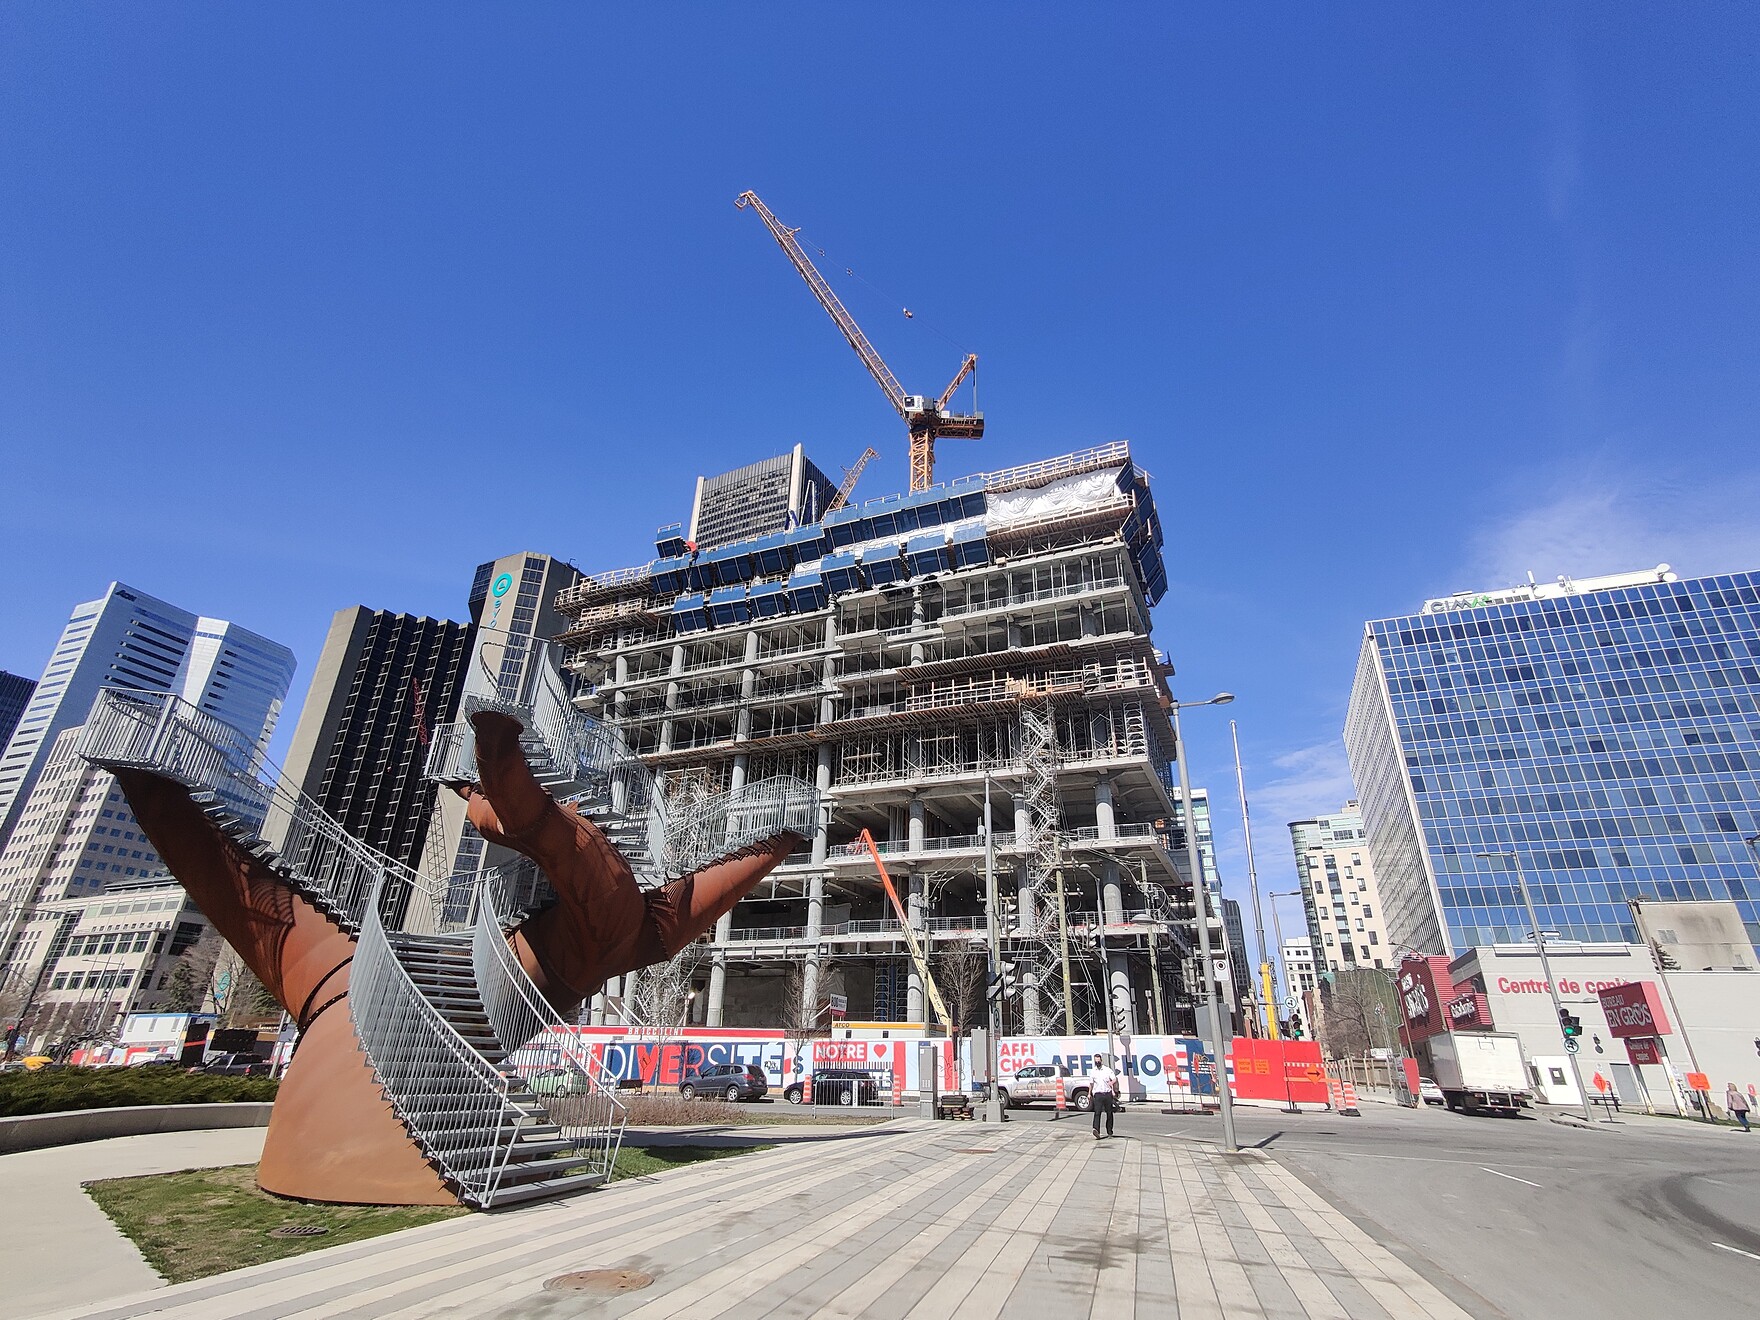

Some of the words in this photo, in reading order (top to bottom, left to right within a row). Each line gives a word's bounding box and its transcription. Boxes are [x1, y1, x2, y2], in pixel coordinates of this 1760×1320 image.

[1498, 977, 1552, 993] Centre
[1559, 978, 1581, 993] de
[1601, 995, 1625, 1008] BUREAU
[1606, 1009, 1622, 1027] EN
[1620, 1003, 1652, 1026] GROS
[816, 1044, 865, 1059] NOTRE
[1000, 1043, 1035, 1056] AFFI
[1051, 1054, 1162, 1077] AFFHO
